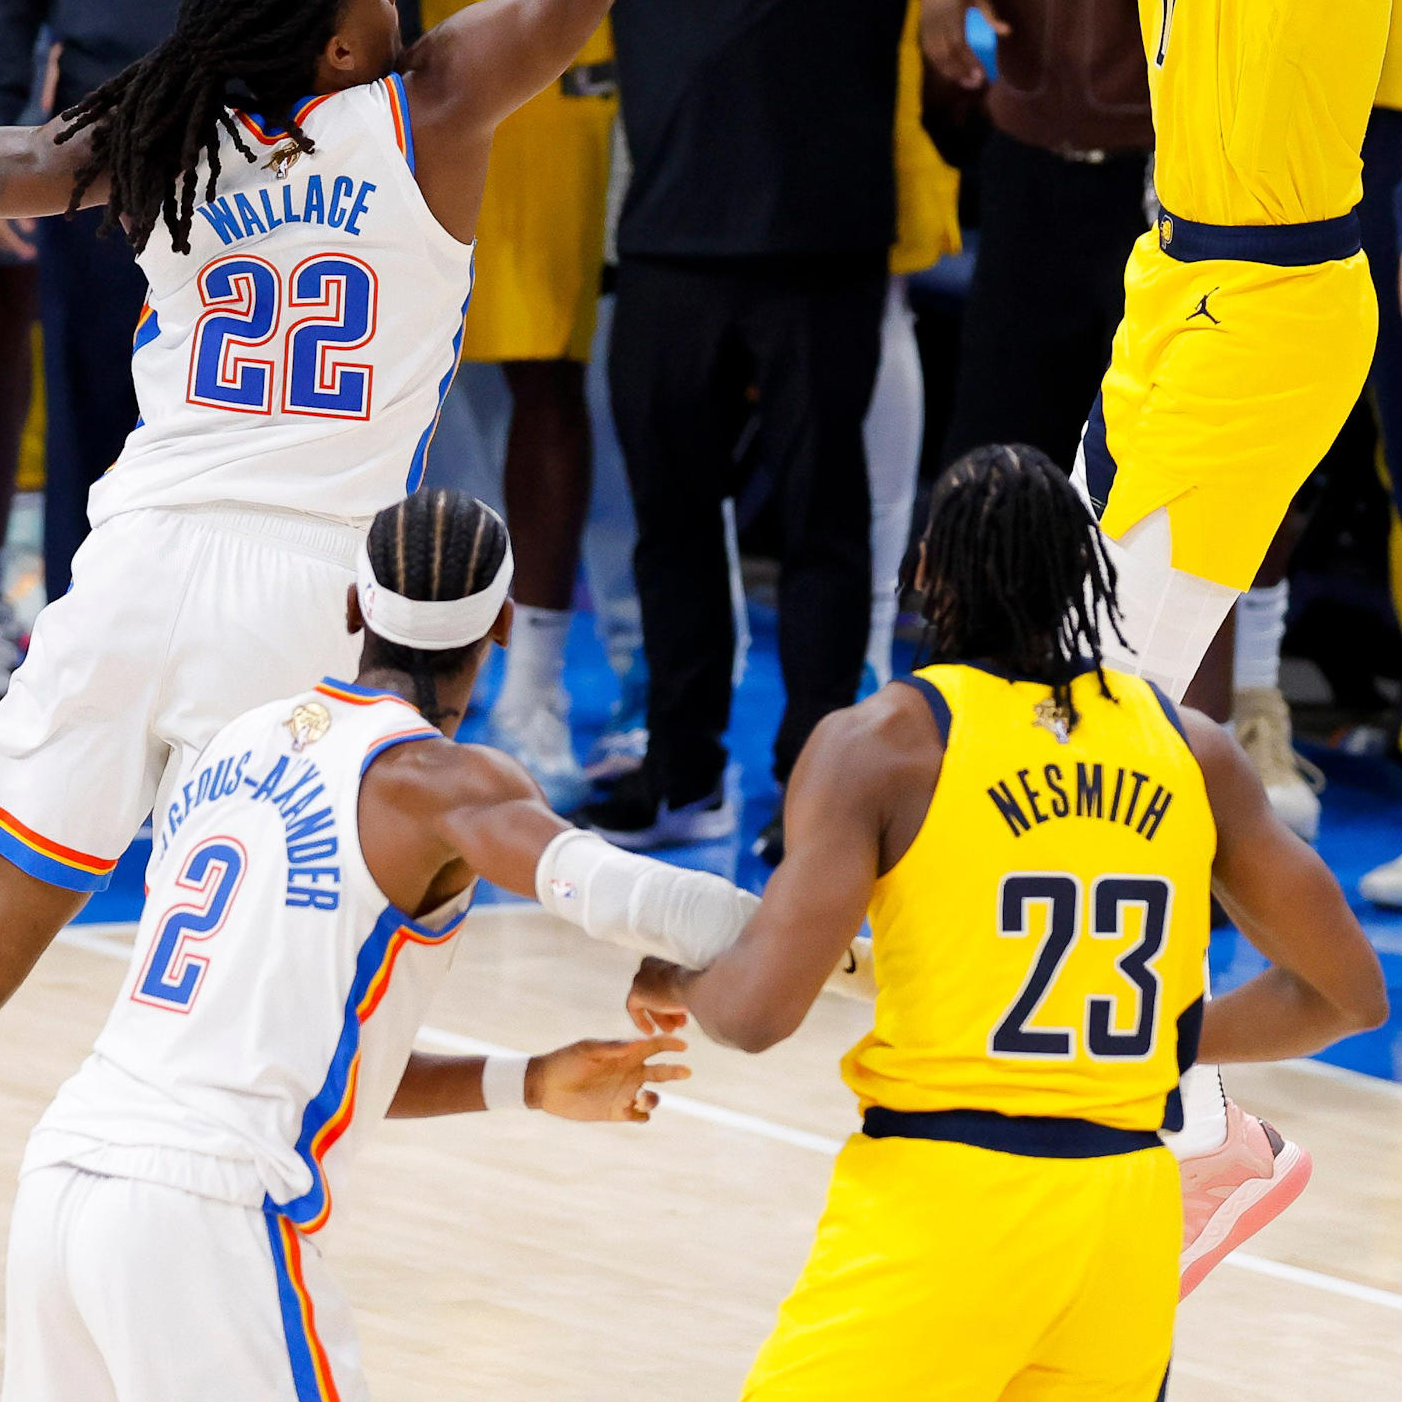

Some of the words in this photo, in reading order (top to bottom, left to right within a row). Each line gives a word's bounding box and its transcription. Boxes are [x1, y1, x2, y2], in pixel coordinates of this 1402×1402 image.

[196, 174, 378, 246] WALLACE
[186, 252, 379, 422] 22
[986, 761, 1174, 841] NESMITH
[131, 834, 249, 1015] 2
[985, 870, 1176, 1063] 23
